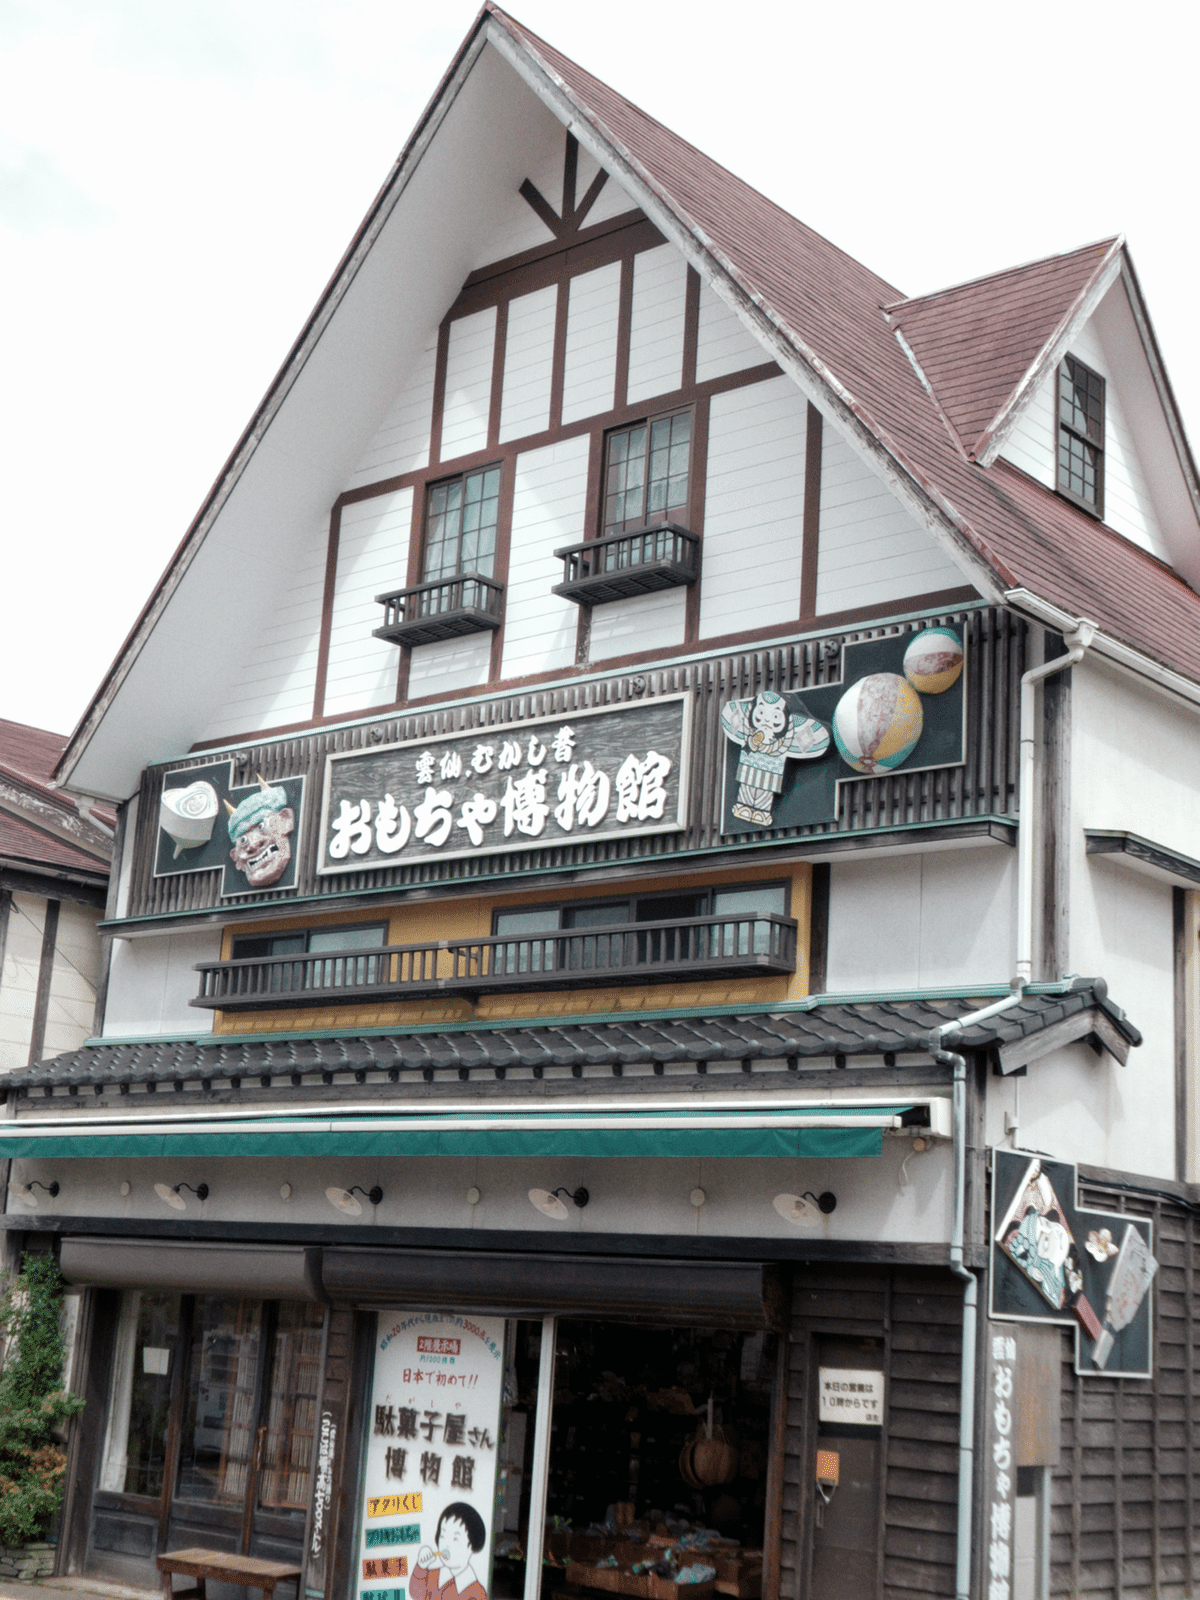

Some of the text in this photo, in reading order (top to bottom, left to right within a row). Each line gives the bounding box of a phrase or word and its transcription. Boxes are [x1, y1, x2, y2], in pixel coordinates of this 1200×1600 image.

[373, 1404, 496, 1450] 駄菓子屋さん
[385, 1446, 475, 1490] 博物館
